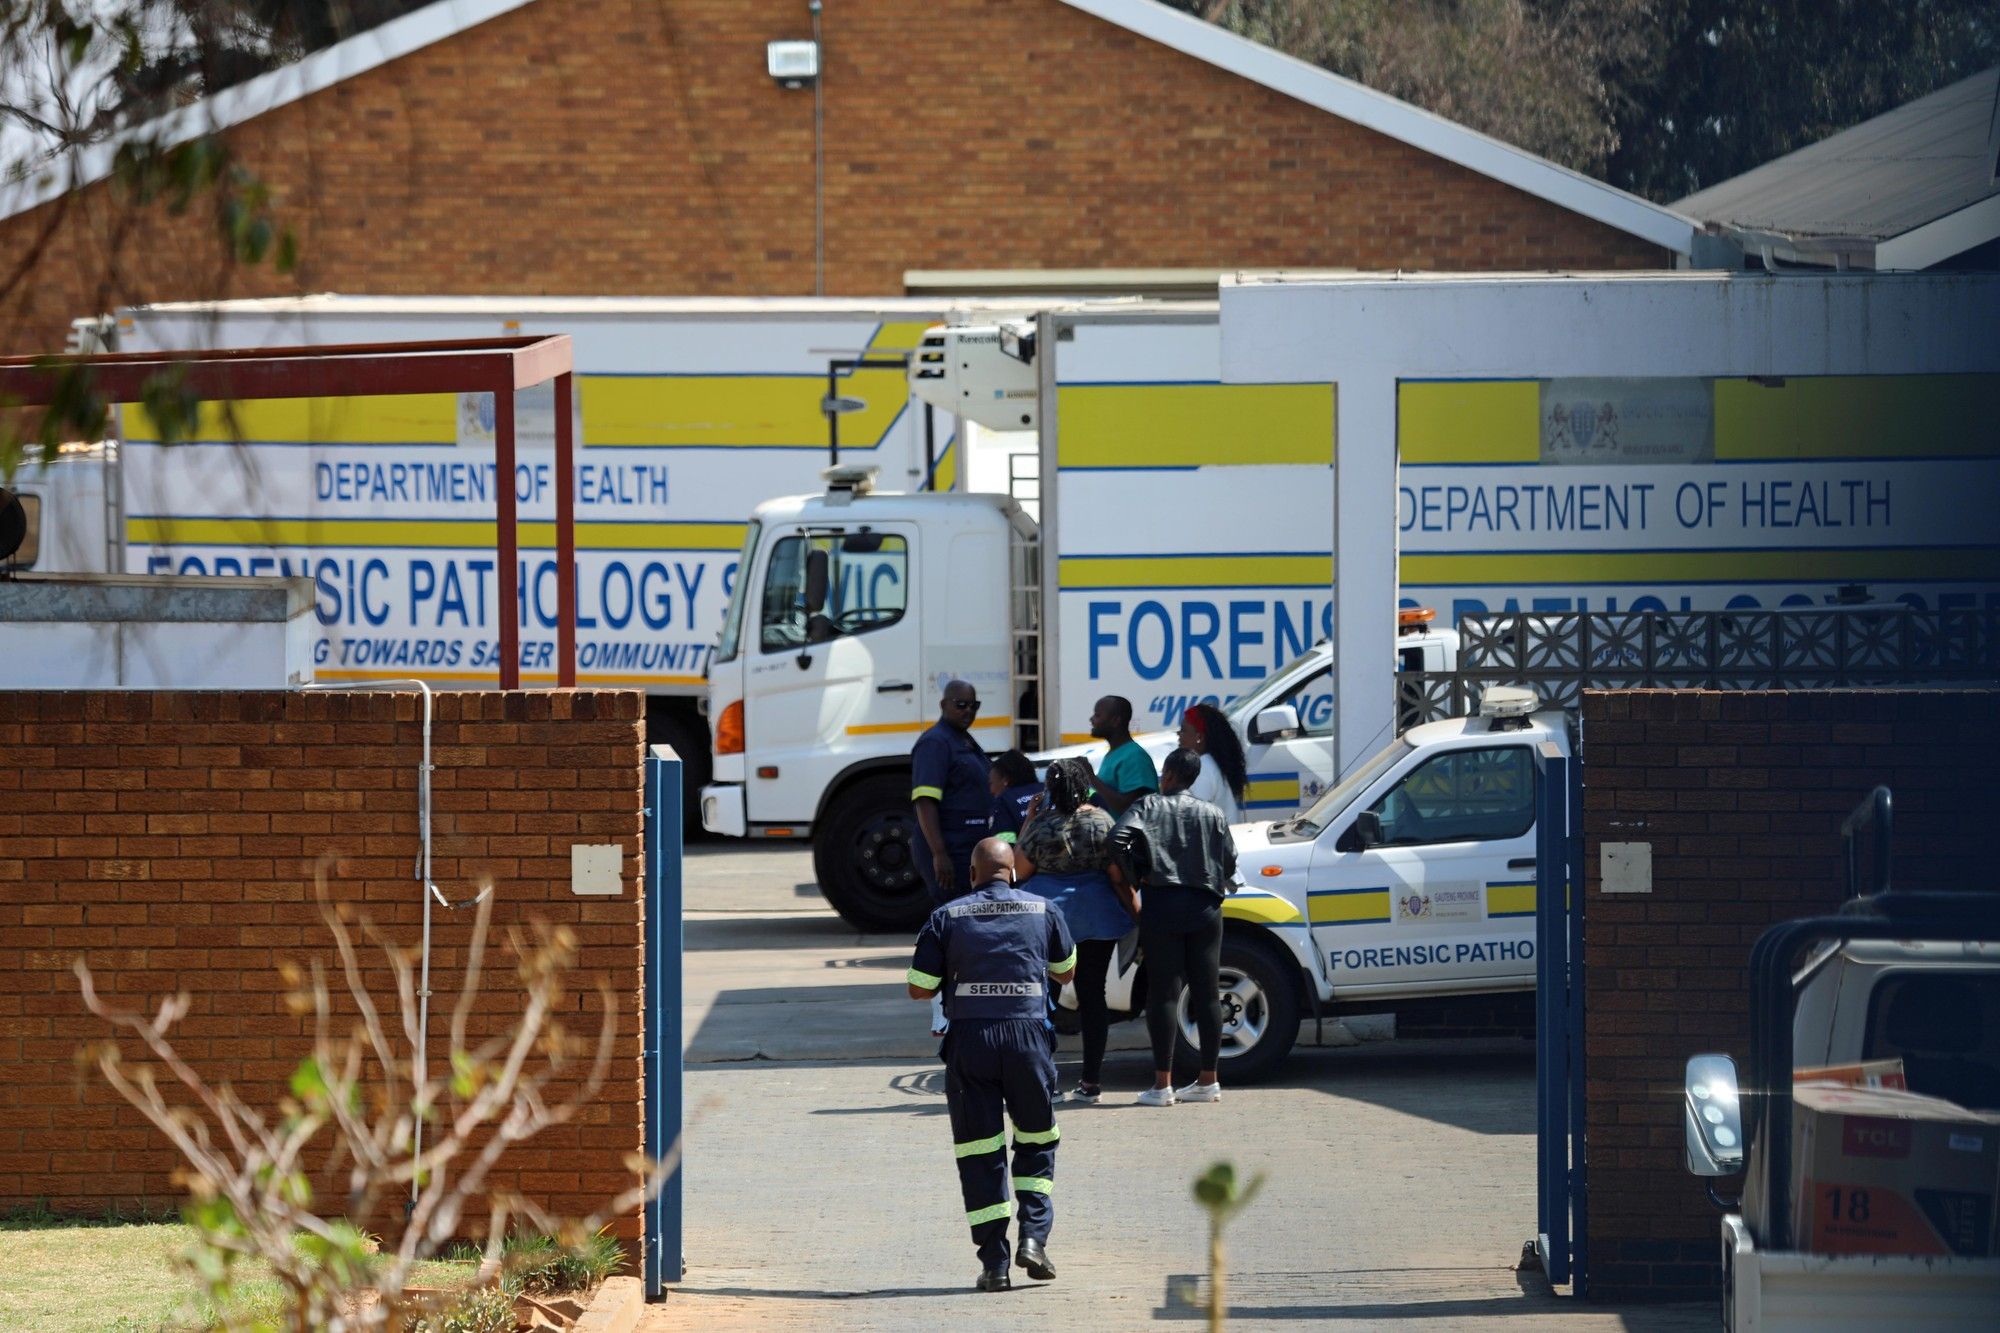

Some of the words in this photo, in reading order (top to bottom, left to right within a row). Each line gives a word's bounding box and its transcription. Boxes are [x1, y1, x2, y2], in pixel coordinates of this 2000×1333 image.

[316, 461, 498, 502] DEPARTMENT
[515, 463, 549, 502] OF
[574, 463, 669, 505] EALTH
[1400, 484, 1654, 532] DEPARTMENT
[1676, 481, 1727, 529] OF
[1742, 480, 1891, 528] HEALTH
[341, 638, 465, 667] TOWARDS
[470, 640, 555, 669] SAER
[575, 642, 708, 670] OMMUNIT
[957, 903, 995, 916] FORENSIC
[996, 902, 1039, 914] PATHOLOGY
[1330, 944, 1451, 970] FORENSIC
[970, 984, 1032, 995] SERVICE
[1854, 1128, 1903, 1147] TCL
[1824, 1187, 1871, 1223] 18
